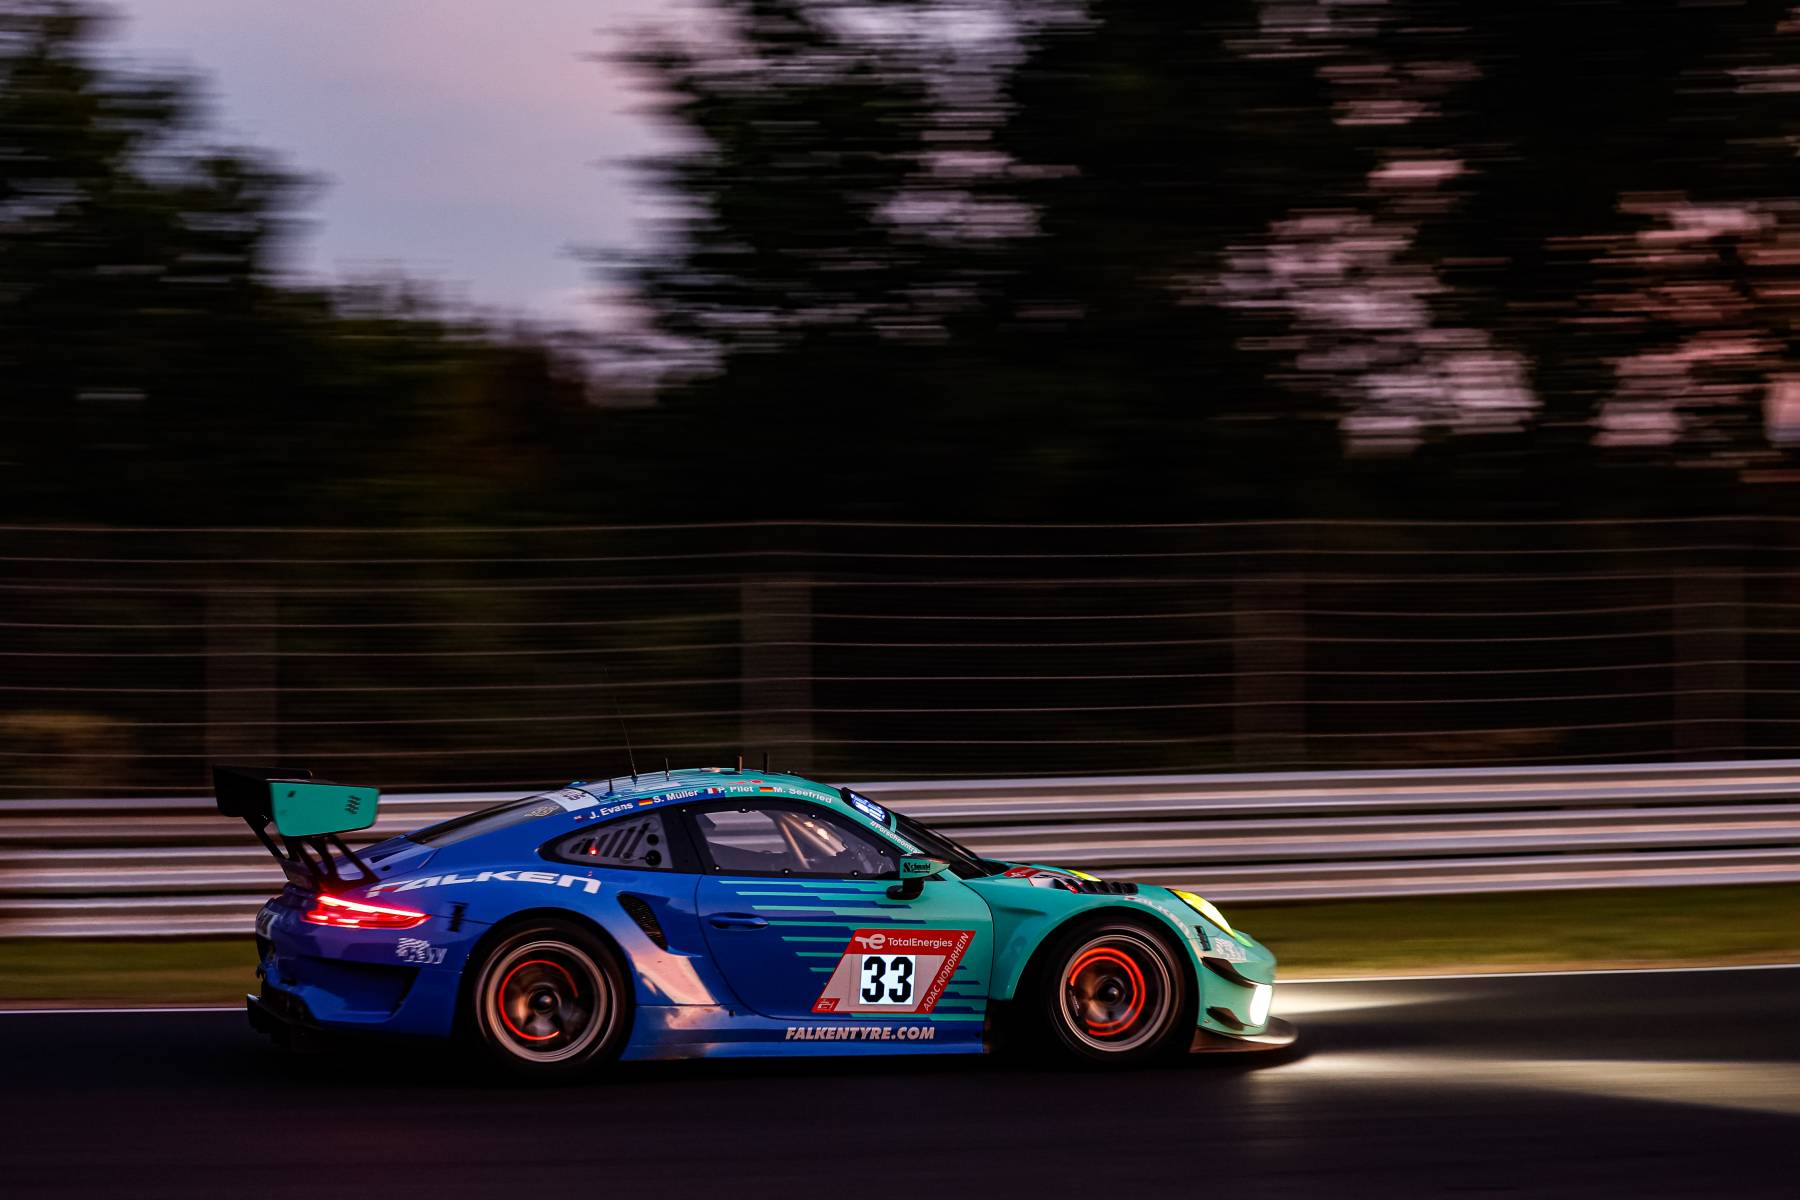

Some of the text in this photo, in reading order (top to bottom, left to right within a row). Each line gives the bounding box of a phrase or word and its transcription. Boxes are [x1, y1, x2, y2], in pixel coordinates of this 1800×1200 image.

[652, 789, 698, 804] S. Müller
[788, 787, 833, 804] Seefried
[589, 802, 634, 820] J. Evans
[365, 870, 602, 899] FALKEN
[887, 937, 953, 949] TotalEnergies
[861, 956, 913, 1003] 33
[923, 931, 969, 1012] ADAC NORDRHEIN
[785, 1026, 936, 1040] FALKENTYRE.COM
